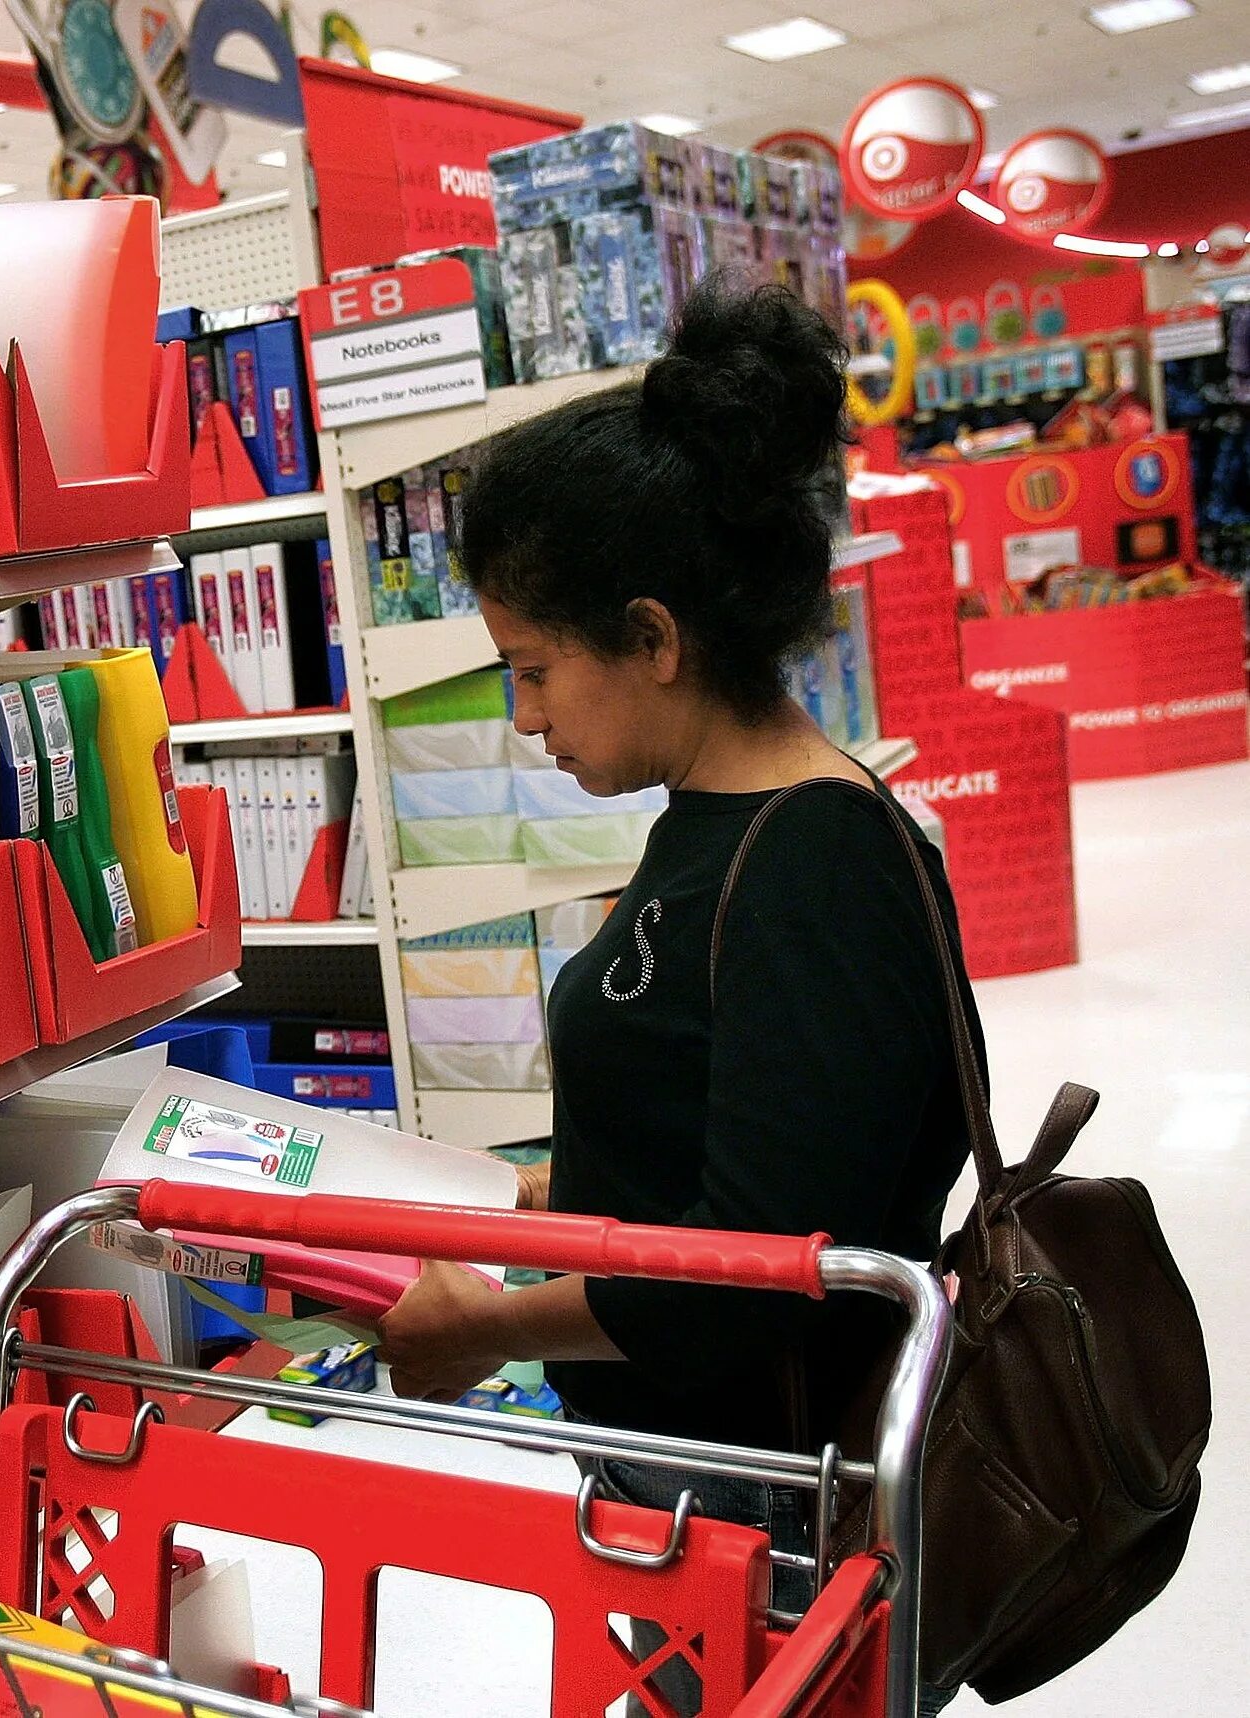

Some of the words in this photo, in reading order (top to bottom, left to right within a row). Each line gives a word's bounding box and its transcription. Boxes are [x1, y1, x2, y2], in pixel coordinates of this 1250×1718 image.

[342, 331, 442, 361] Notebooks
[320, 398, 353, 412] Mead
[354, 395, 378, 408] Five
[382, 390, 405, 402] Star
[408, 377, 476, 397] Notebooks
[1069, 707, 1137, 729] POWER
[1142, 702, 1164, 722] TO
[891, 769, 999, 800] EDUCATE
